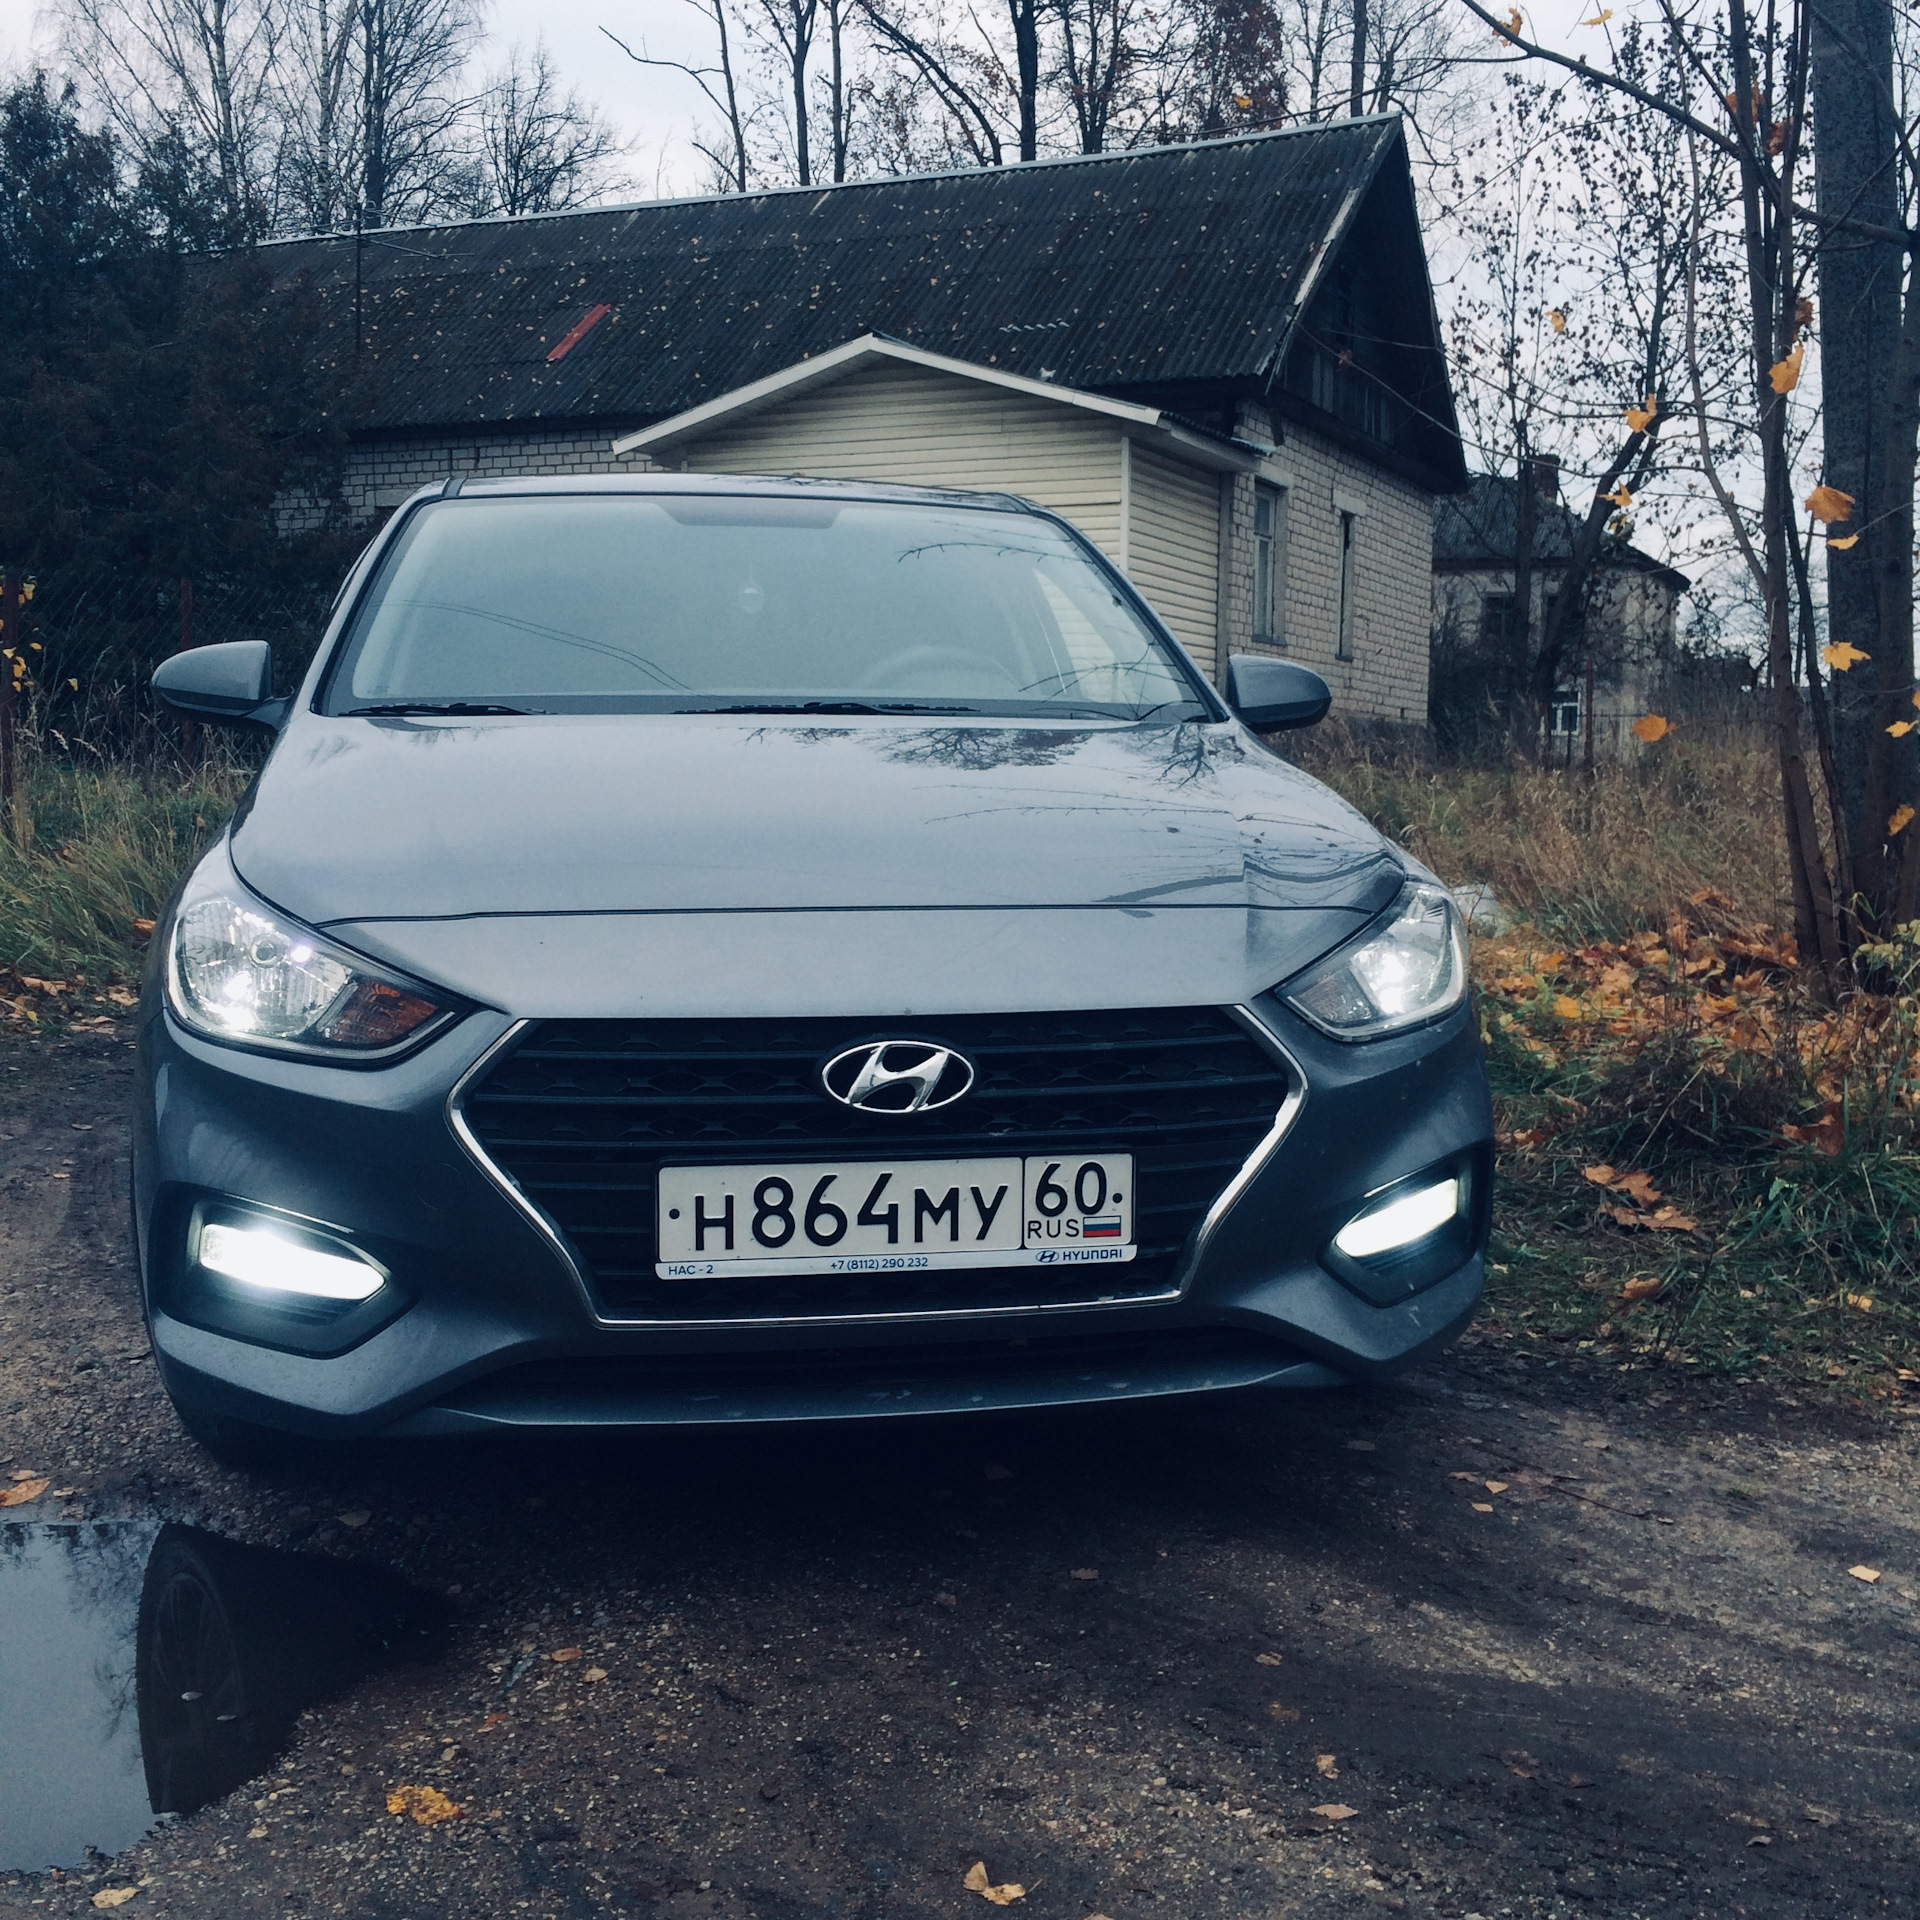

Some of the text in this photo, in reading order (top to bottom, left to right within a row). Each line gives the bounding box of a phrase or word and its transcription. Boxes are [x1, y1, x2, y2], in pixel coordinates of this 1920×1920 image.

[1035, 1161, 1107, 1217] 60
[1027, 1219, 1080, 1239] RUS
[1063, 1249, 1122, 1261] HYUNDAI
[830, 1257, 928, 1271] +7 (8112) 290 232
